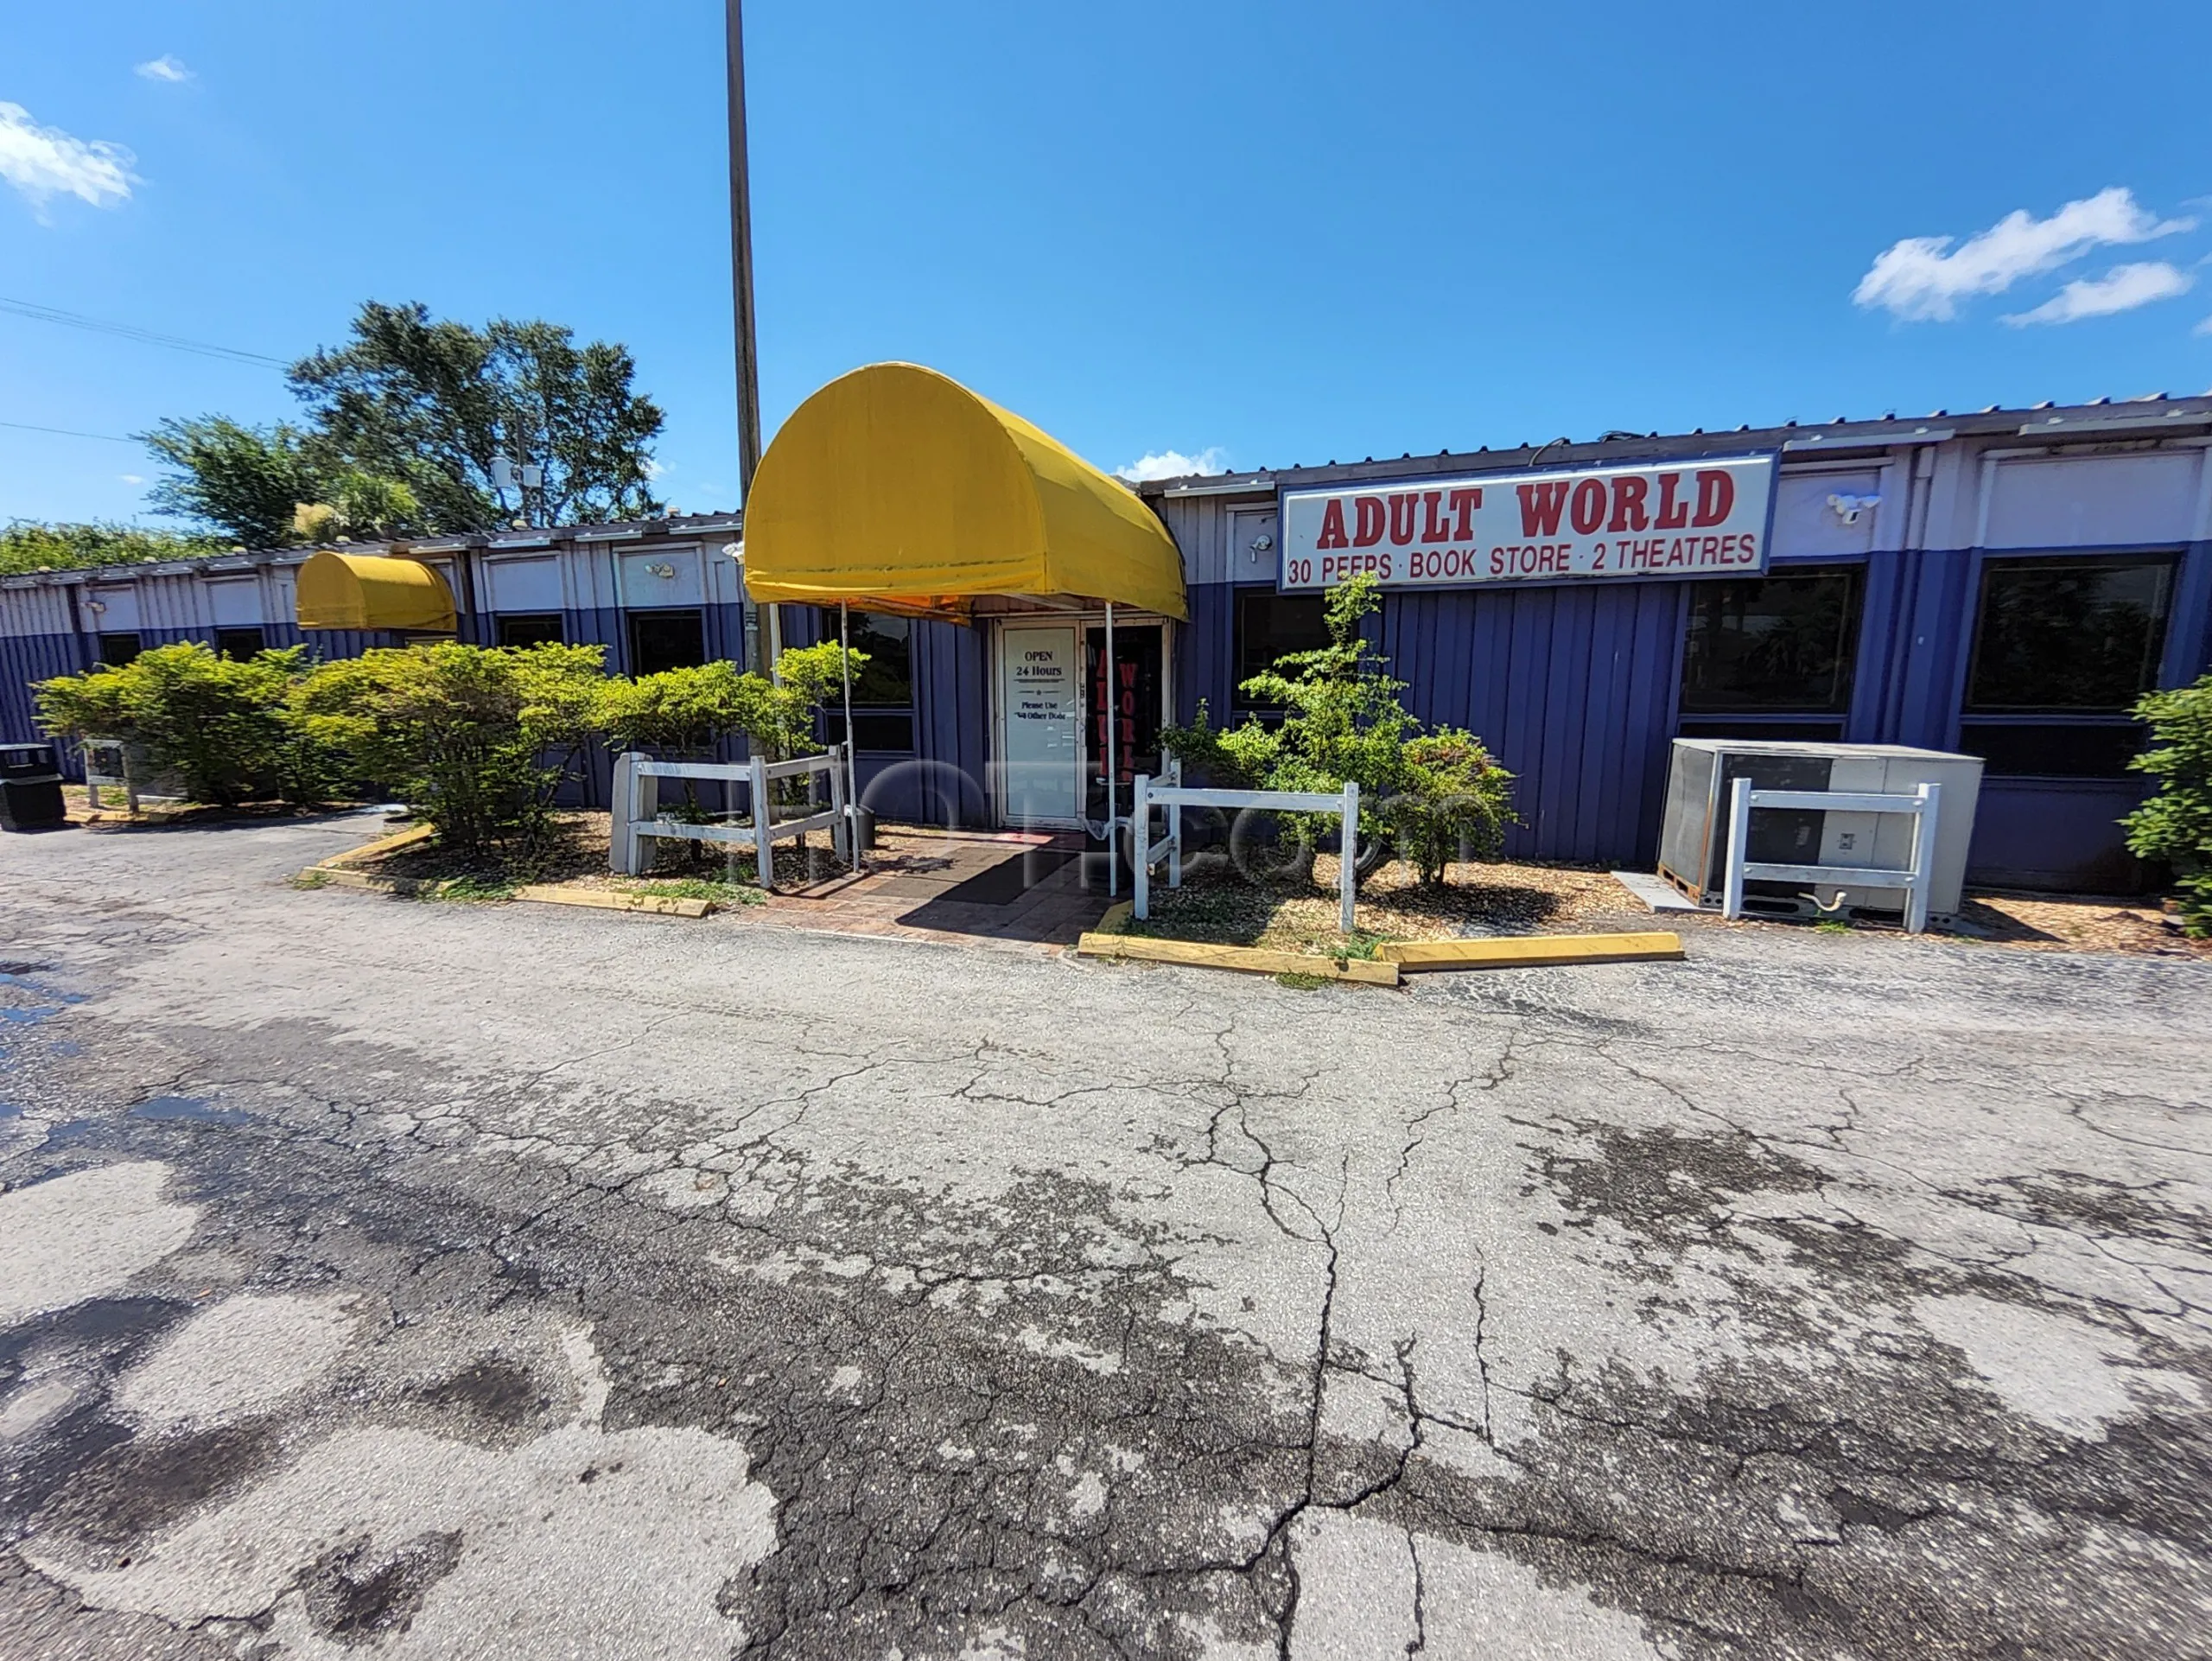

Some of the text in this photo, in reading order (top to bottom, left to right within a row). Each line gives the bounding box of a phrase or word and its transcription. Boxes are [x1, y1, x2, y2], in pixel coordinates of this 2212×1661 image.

[1316, 469, 1735, 550] ADULT WORLD
[1288, 533, 1755, 584] 30 PEEPS BOOK STORE 2 THEATRES
[1024, 651, 1053, 662] OPEN
[1016, 665, 1063, 676] 24 Hours
[1021, 701, 1044, 710] Please
